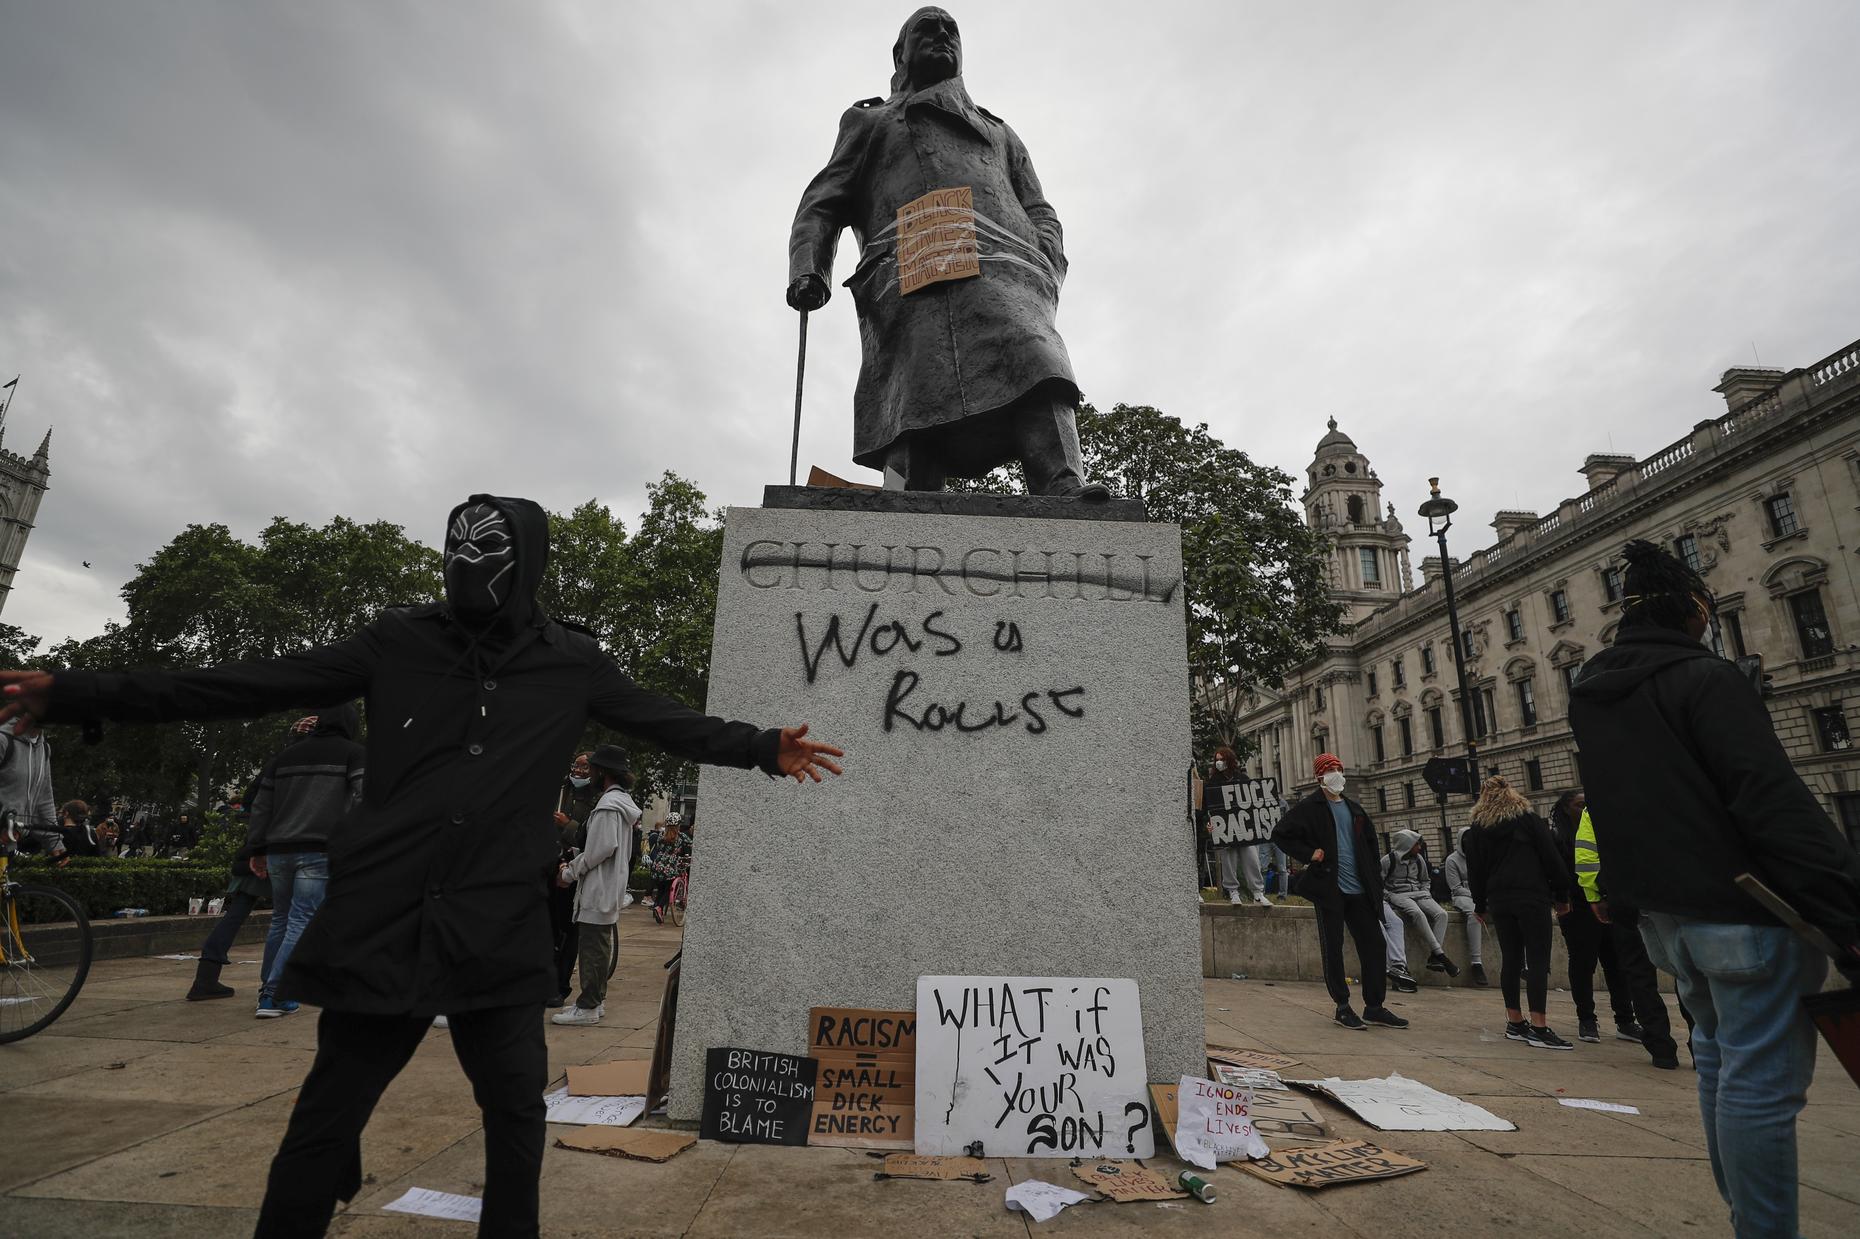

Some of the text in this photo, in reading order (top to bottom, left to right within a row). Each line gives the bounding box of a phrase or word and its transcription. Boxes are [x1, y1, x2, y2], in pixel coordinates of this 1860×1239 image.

[902, 188, 972, 235] BLACK
[901, 216, 976, 257] LIVES
[740, 539, 1174, 603] CHURCHILL
[796, 603, 1024, 684] Was a
[1221, 778, 1278, 811] FUCK
[1210, 806, 1281, 845] RACISM
[933, 983, 1053, 1038] WHAT
[815, 1015, 916, 1048] RACISM
[727, 1050, 799, 1078] BRITISH
[993, 1034, 1116, 1078] IT WAS
[714, 1071, 815, 1102] COLONIALISM
[822, 1069, 902, 1089] SMALL
[1195, 1082, 1253, 1102] IGNORA
[725, 1093, 777, 1114] IS TO
[831, 1092, 884, 1112] DICK
[984, 1067, 1085, 1129] YOUR
[1216, 1102, 1248, 1116] ENDS
[719, 1111, 784, 1140] BLAME
[814, 1113, 901, 1134] ENERGY
[1026, 1111, 1104, 1154] SON
[1250, 1152, 1334, 1172] BLACK
[1294, 1158, 1409, 1179] MATTER
[1108, 1185, 1171, 1195] MATTER
[1110, 1178, 1156, 1187] LIVES
